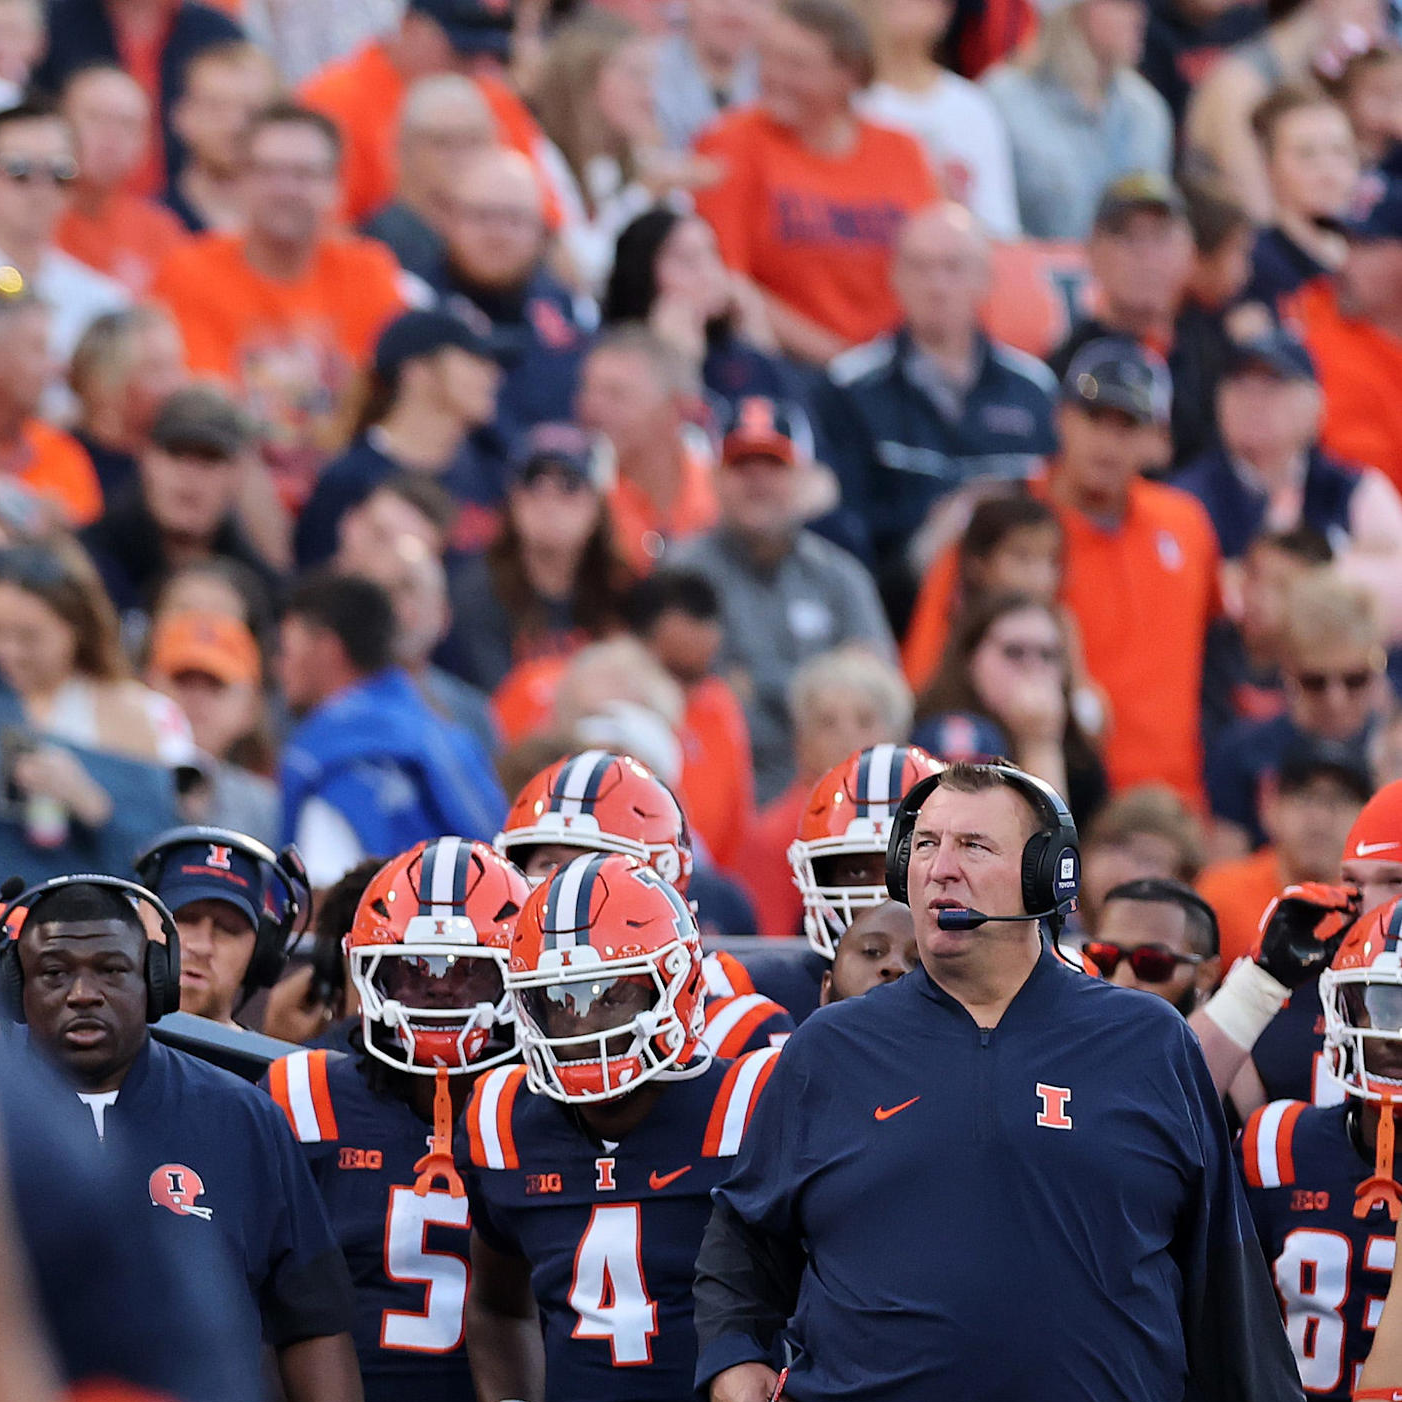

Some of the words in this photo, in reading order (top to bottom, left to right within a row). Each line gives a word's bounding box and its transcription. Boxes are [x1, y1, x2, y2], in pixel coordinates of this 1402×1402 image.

[1036, 1082, 1072, 1130] I
[166, 1170, 186, 1195] I
[595, 1157, 617, 1191] I
[380, 1184, 471, 1353] 5
[567, 1202, 659, 1367] 4
